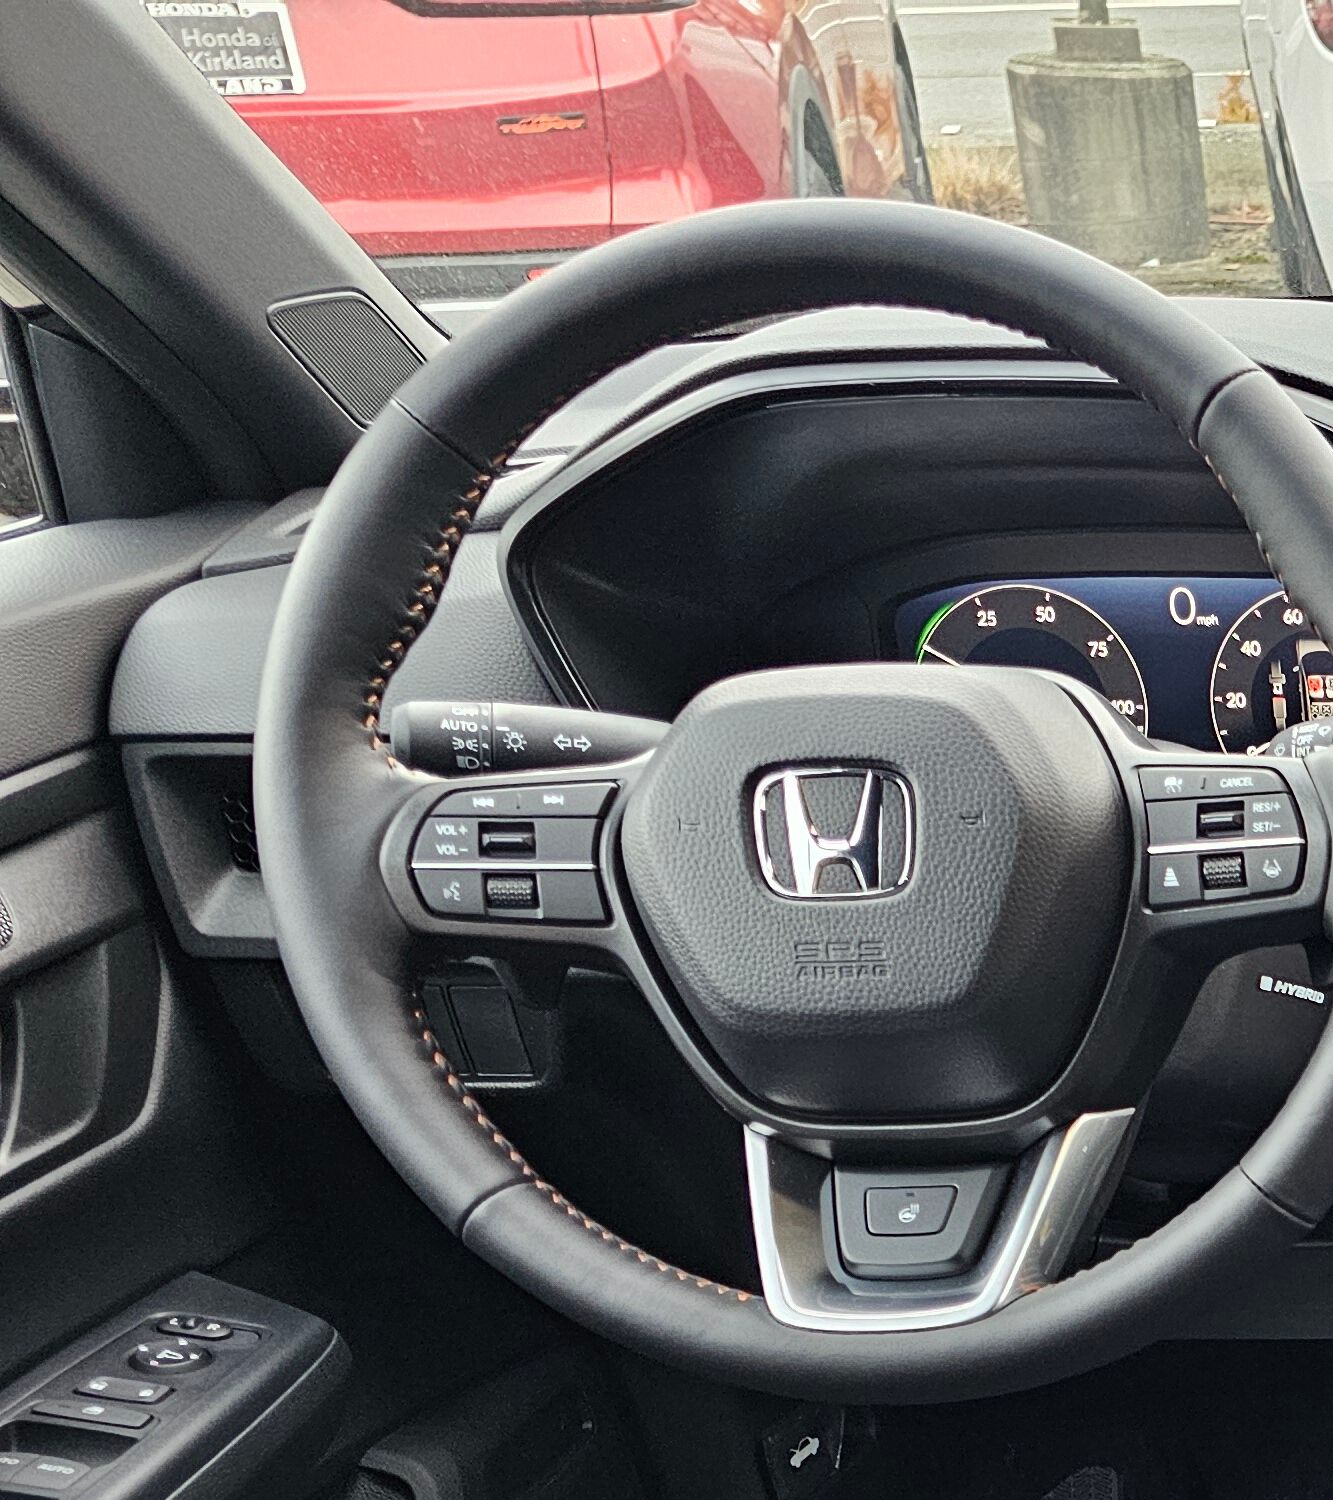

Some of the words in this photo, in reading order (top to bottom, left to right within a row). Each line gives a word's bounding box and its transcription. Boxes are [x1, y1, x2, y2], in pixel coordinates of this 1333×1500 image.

[146, 3, 238, 16] HONDA
[181, 26, 261, 47] Honda
[1169, 586, 1196, 625] 0
[1197, 613, 1219, 628] mph
[977, 610, 997, 628] 25
[1035, 607, 1055, 624] 50
[1282, 609, 1303, 625] 60
[1088, 641, 1108, 658] 75
[1240, 641, 1262, 657] 40
[1226, 692, 1246, 709] 20
[440, 719, 478, 733] AUTO
[1297, 735, 1315, 746] OFF
[1219, 777, 1254, 788] CANCEL
[795, 963, 890, 979] AIRBAG
[1274, 980, 1325, 1004] HYBRID
